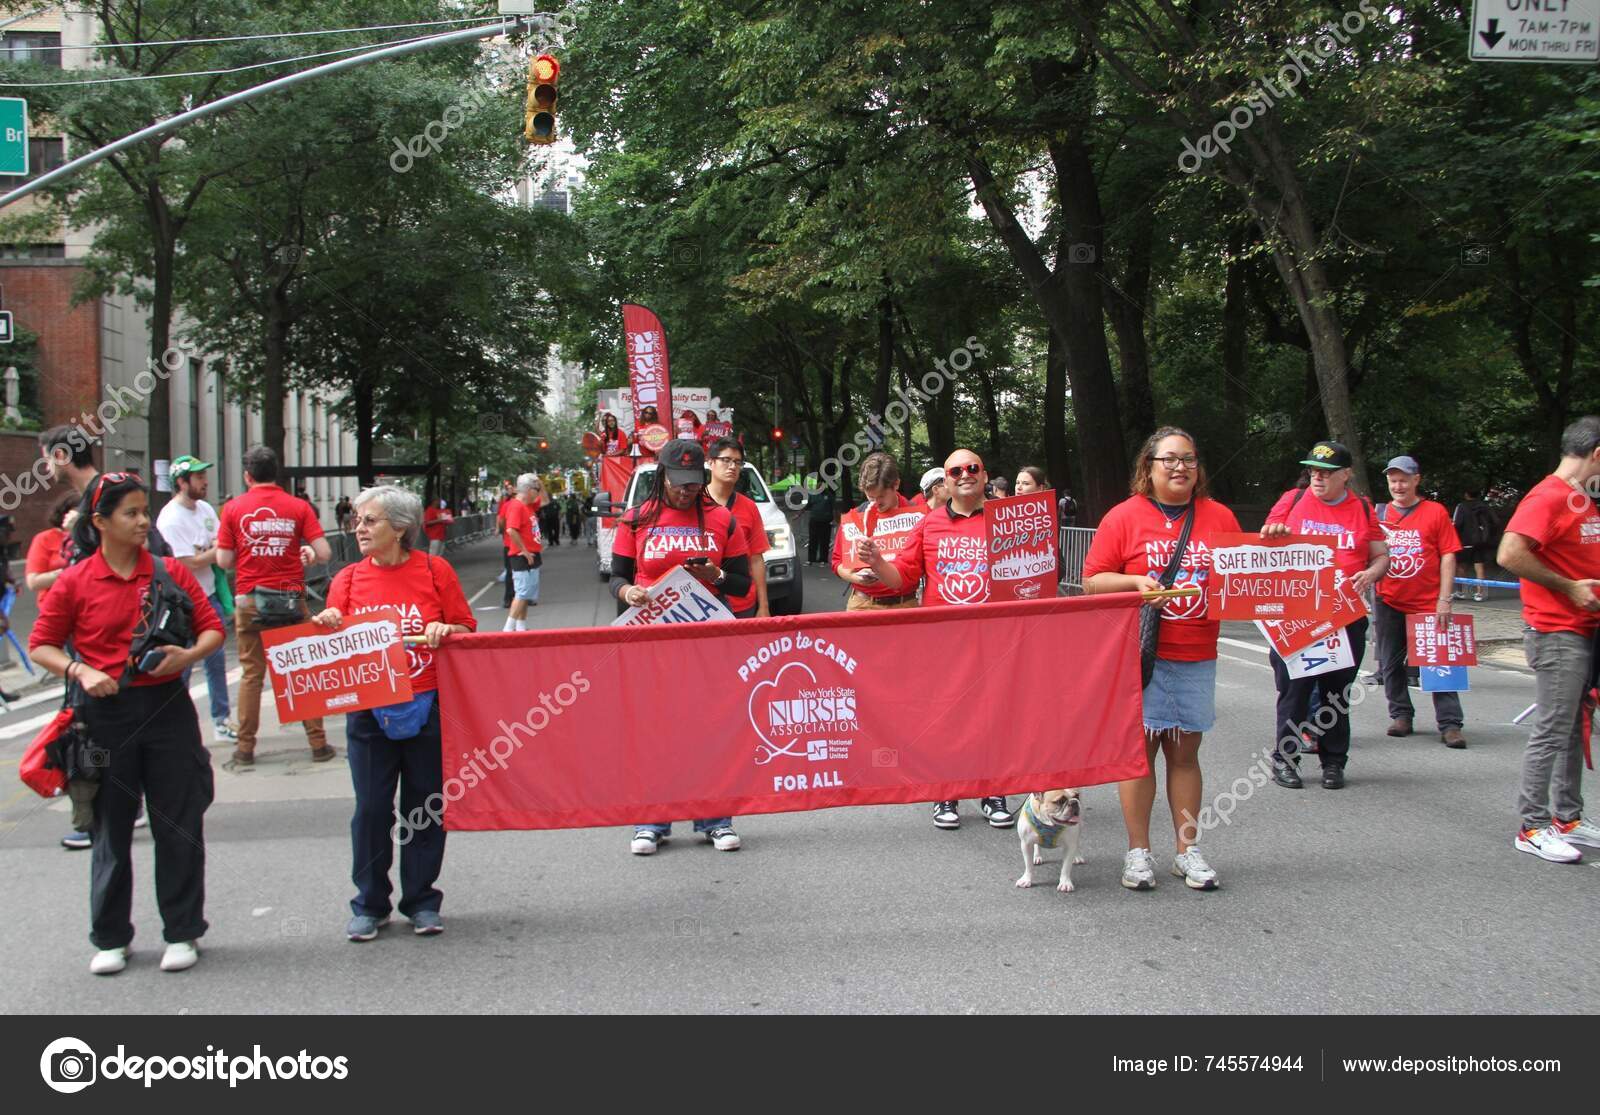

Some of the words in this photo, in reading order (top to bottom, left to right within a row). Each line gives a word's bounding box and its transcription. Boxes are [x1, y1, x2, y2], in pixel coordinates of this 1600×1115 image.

[1509, 39, 1537, 52] MON
[1541, 41, 1569, 52] THRU
[1576, 40, 1596, 52] FRI
[691, 393, 708, 402] Care
[995, 500, 1047, 521] UNION
[992, 515, 1052, 536] NURSES
[645, 535, 719, 552] KAMALA
[888, 536, 908, 550] LIVE
[991, 532, 1030, 553] Care
[1032, 529, 1053, 547] for
[251, 546, 287, 557] STAFF
[1147, 553, 1210, 568] NUSES
[1219, 553, 1247, 569] SAFE
[1251, 552, 1267, 568] RN
[1270, 550, 1325, 567] STAFFING
[973, 560, 988, 574] fo
[994, 566, 1021, 578] NEW
[1024, 560, 1054, 575] YORK
[1391, 560, 1408, 570] NY
[952, 579, 976, 593] NY
[1231, 578, 1272, 597] SAVES
[1274, 579, 1308, 598] LIVES
[626, 586, 680, 626] URSES
[680, 582, 692, 597] for
[1284, 619, 1318, 638] SAVE
[275, 646, 307, 669] SAFE
[307, 641, 328, 661] RN
[328, 626, 391, 656] STAFFING
[1415, 623, 1426, 657] MORE
[1425, 615, 1437, 663] NURSES
[1448, 621, 1457, 662] BETTE
[1454, 624, 1463, 655] CARE
[738, 636, 793, 682] PROUD
[796, 631, 813, 649] to
[814, 638, 858, 675] CARE
[293, 669, 340, 696] SAVES
[341, 662, 380, 687] LIVES
[798, 688, 817, 698] New
[817, 687, 836, 698] York
[836, 686, 855, 697] State
[769, 697, 856, 727] NURSES
[770, 720, 859, 736] ASSOCIATION
[774, 774, 807, 792] FOR
[812, 771, 843, 789] ALL
